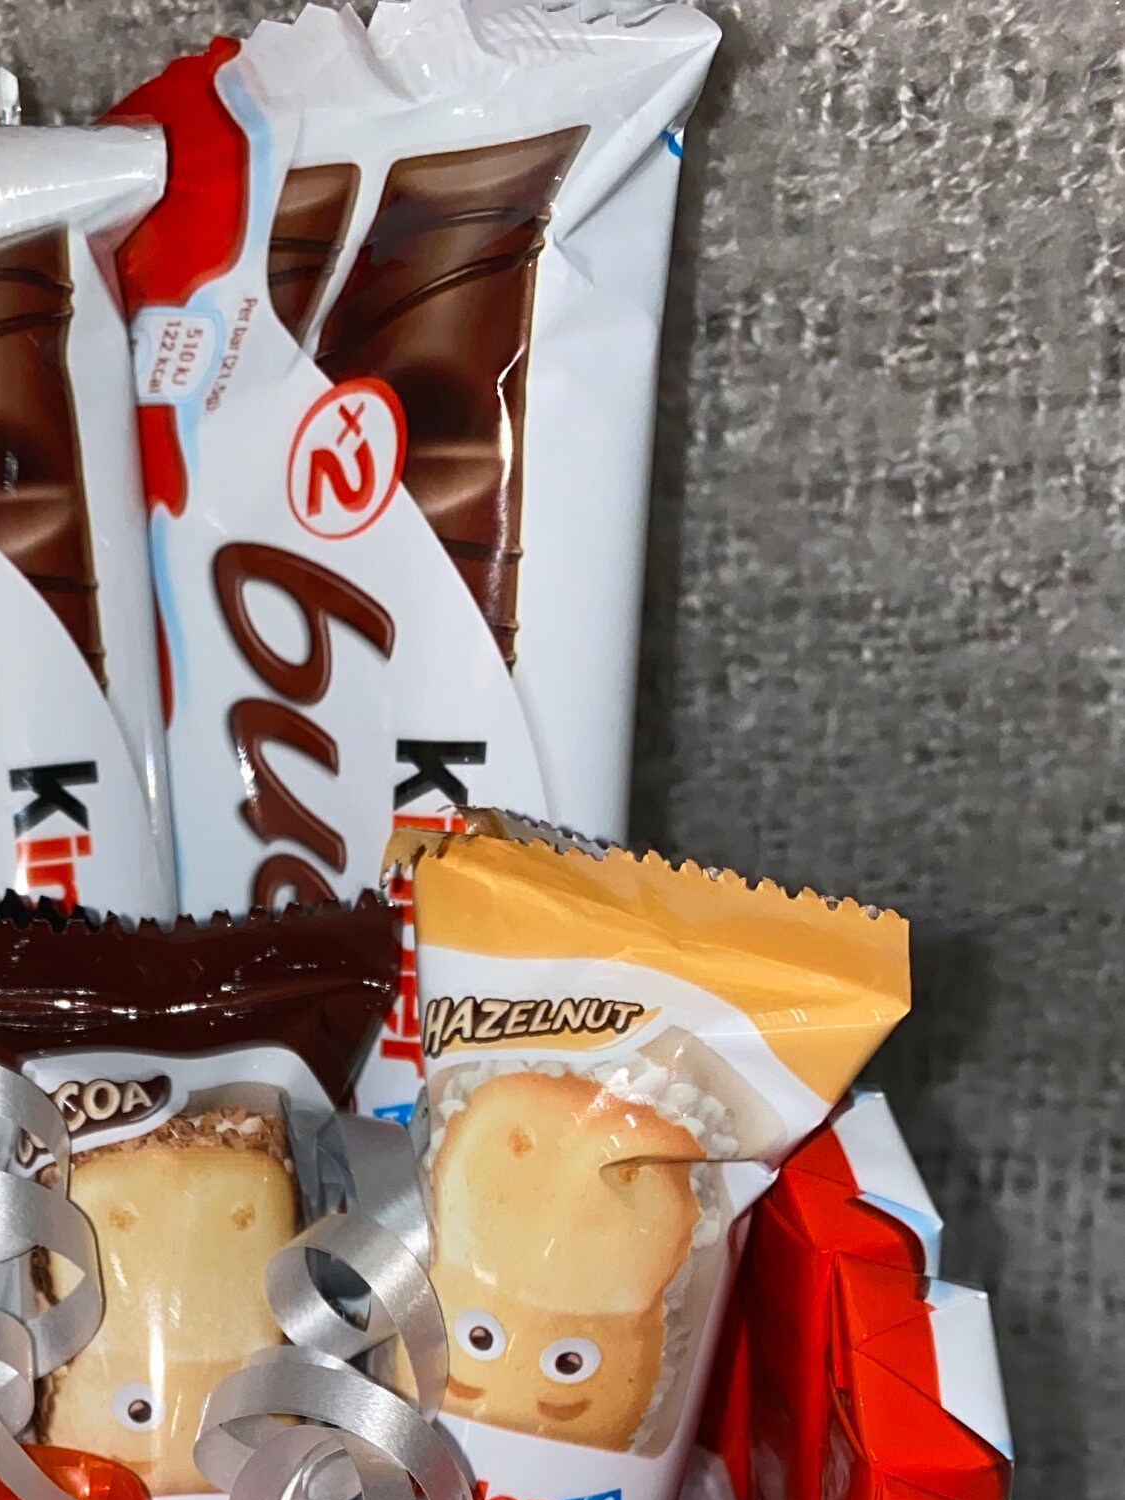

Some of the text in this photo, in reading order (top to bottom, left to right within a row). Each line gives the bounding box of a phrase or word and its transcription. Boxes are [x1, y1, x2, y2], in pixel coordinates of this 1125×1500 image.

[149, 321, 182, 394] 122 kcal
[171, 327, 203, 386] 510 kJ
[424, 996, 644, 1058] HAZELNUT
